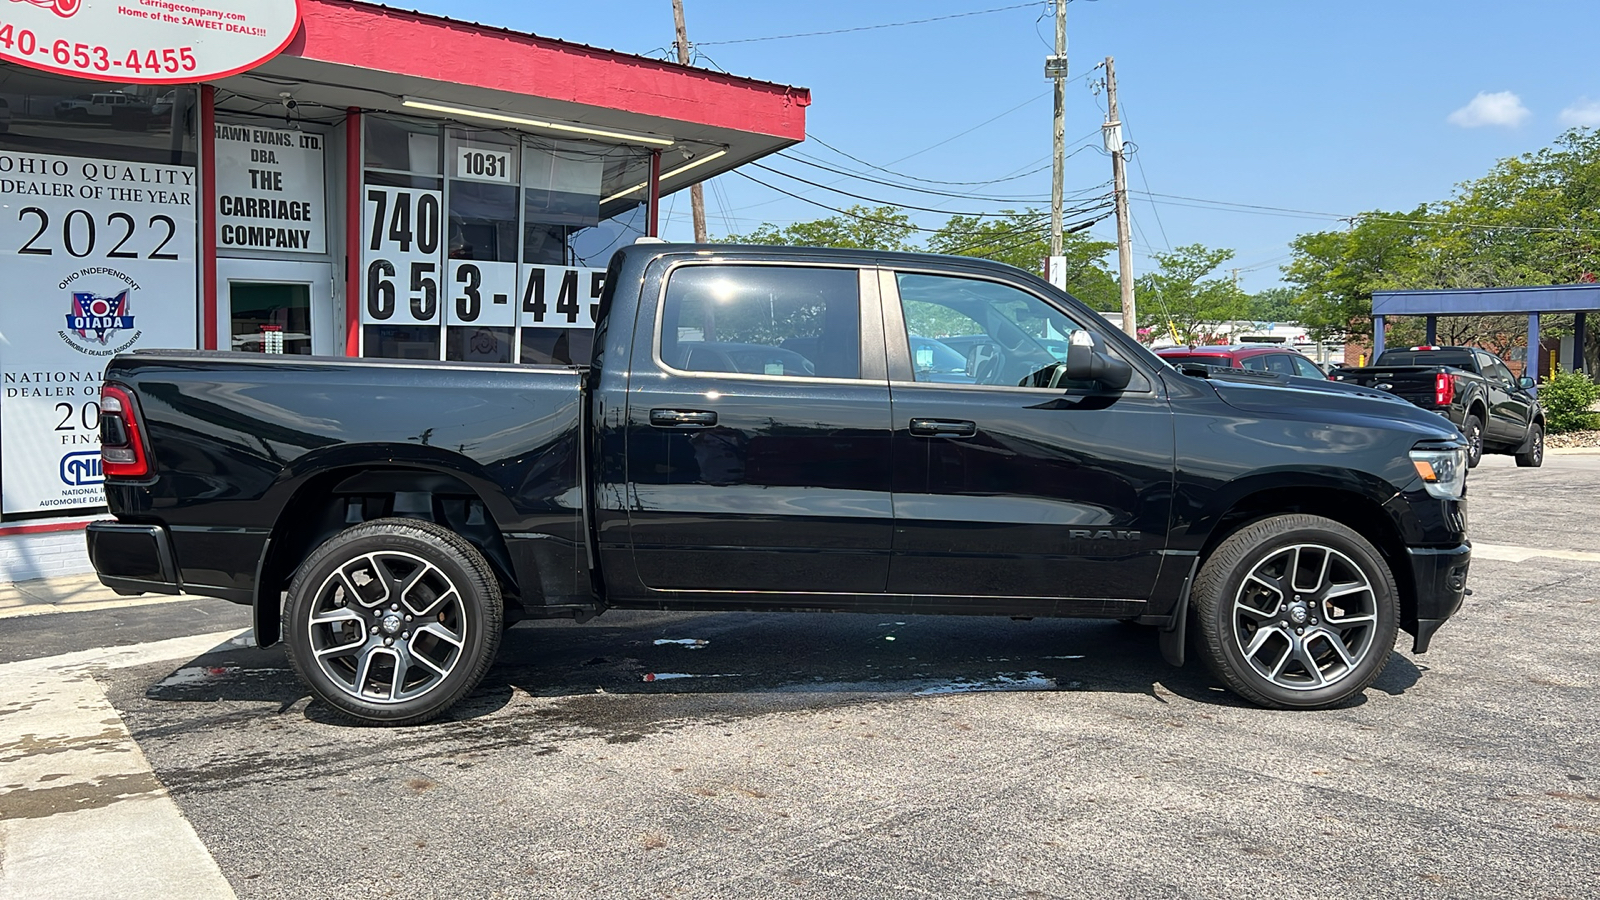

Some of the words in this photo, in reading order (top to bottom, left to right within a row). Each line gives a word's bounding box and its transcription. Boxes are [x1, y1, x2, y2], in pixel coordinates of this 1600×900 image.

[118, 6, 148, 19] Home
[150, 11, 161, 20] of
[163, 14, 180, 24] the
[182, 17, 224, 31] SAWEET
[225, 23, 267, 37] DEALS!!!
[0, 22, 197, 74] 40-653-4455
[253, 130, 294, 147] EVANS.
[300, 135, 322, 150] LTD.
[251, 149, 279, 164] DBA.
[463, 152, 506, 177] 1031
[0, 156, 69, 176] OHIO
[82, 162, 194, 186] QUALITY
[248, 169, 283, 191] THE
[1, 179, 75, 198] DEALER
[79, 185, 103, 199] OF
[108, 187, 143, 202] THE
[147, 190, 192, 206] YEAR
[219, 195, 311, 222] CARRIAGE
[17, 206, 179, 260] 2022
[368, 190, 439, 254] 740
[221, 224, 311, 249] COMPANY
[58, 272, 80, 289] OHIO
[80, 267, 141, 291] INDEPENDENT
[74, 317, 123, 328] OIADA
[58, 330, 88, 354] AUTOMOBILE
[113, 330, 142, 354] ASSOCIATION
[4, 371, 104, 383] NATIONAL
[7, 386, 75, 398] DEALER
[54, 401, 101, 431] 20
[39, 496, 87, 507] AUTOMOBILE
[62, 488, 98, 496] NATIONAL
[1068, 529, 1141, 541] RAM
